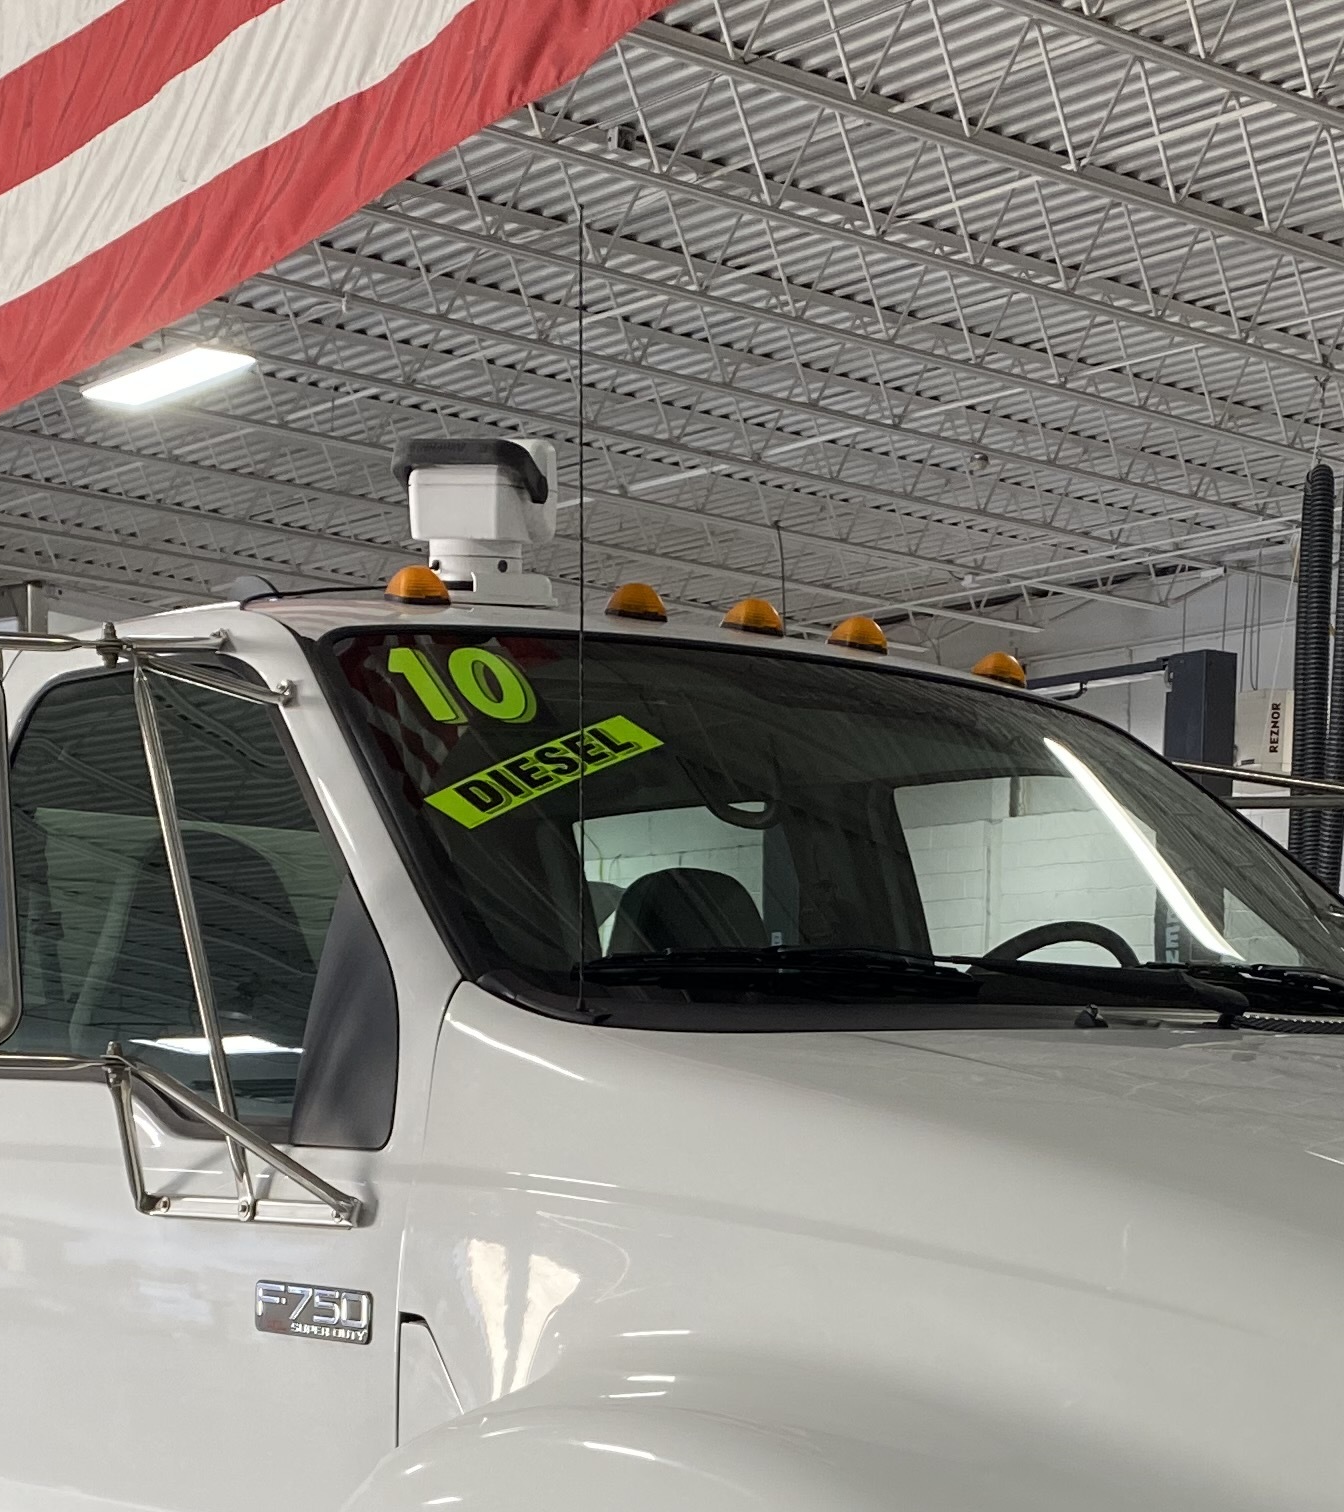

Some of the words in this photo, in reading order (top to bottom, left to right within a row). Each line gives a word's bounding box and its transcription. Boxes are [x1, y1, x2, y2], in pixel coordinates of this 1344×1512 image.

[387, 646, 537, 724] 10
[1268, 702, 1282, 753] REZNOR
[453, 726, 641, 815] DIESEL
[291, 1322, 330, 1338] SUPER
[332, 1327, 368, 1342] DUTY
